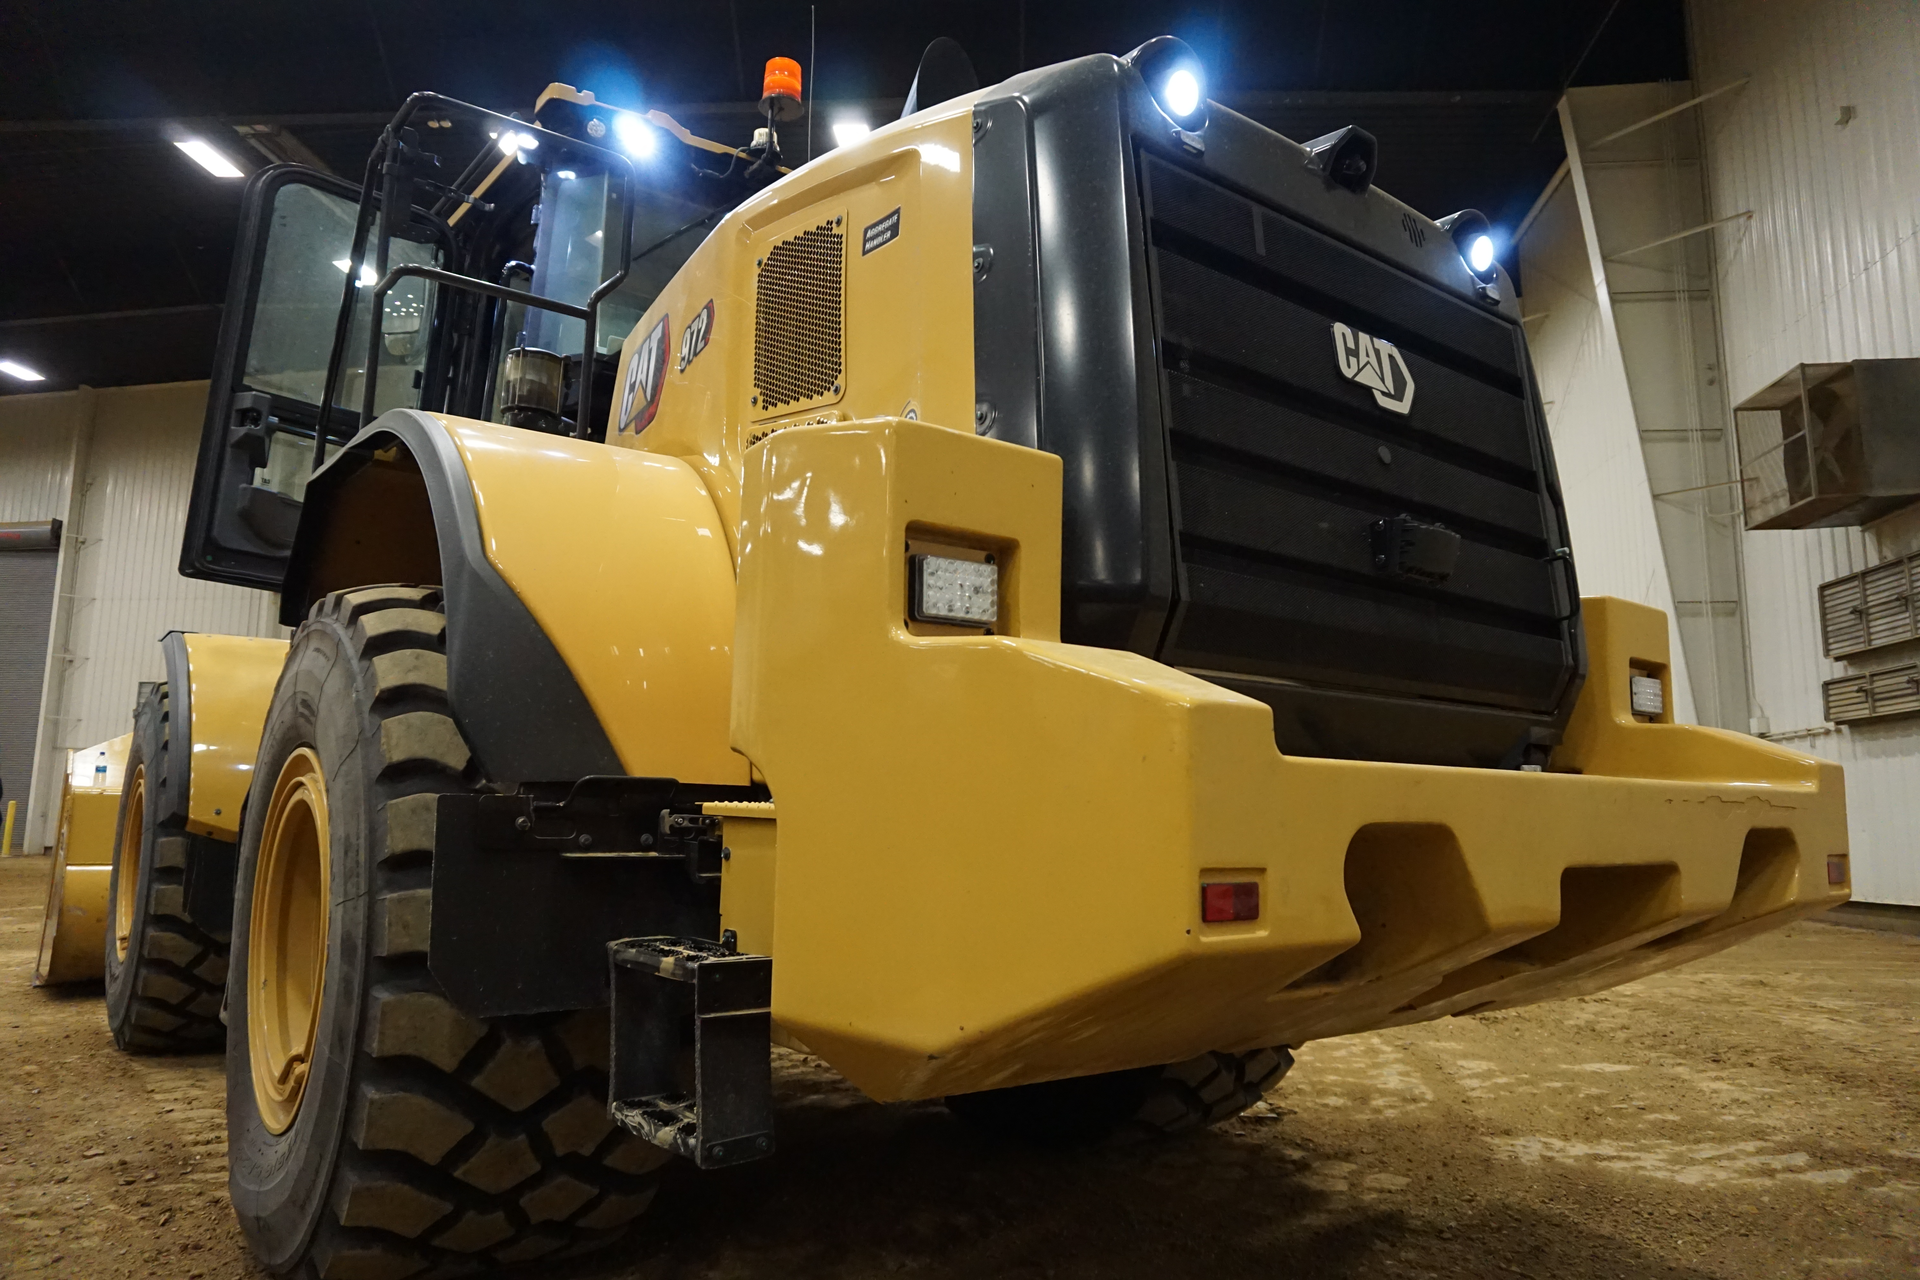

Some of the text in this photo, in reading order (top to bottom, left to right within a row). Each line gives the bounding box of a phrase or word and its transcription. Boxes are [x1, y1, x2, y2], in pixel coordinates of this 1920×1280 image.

[864, 230, 891, 251] HANDLER
[865, 213, 899, 240] AGGREGATE
[680, 308, 708, 371] 972
[1333, 321, 1395, 396] CAT
[619, 320, 663, 431] CAT
